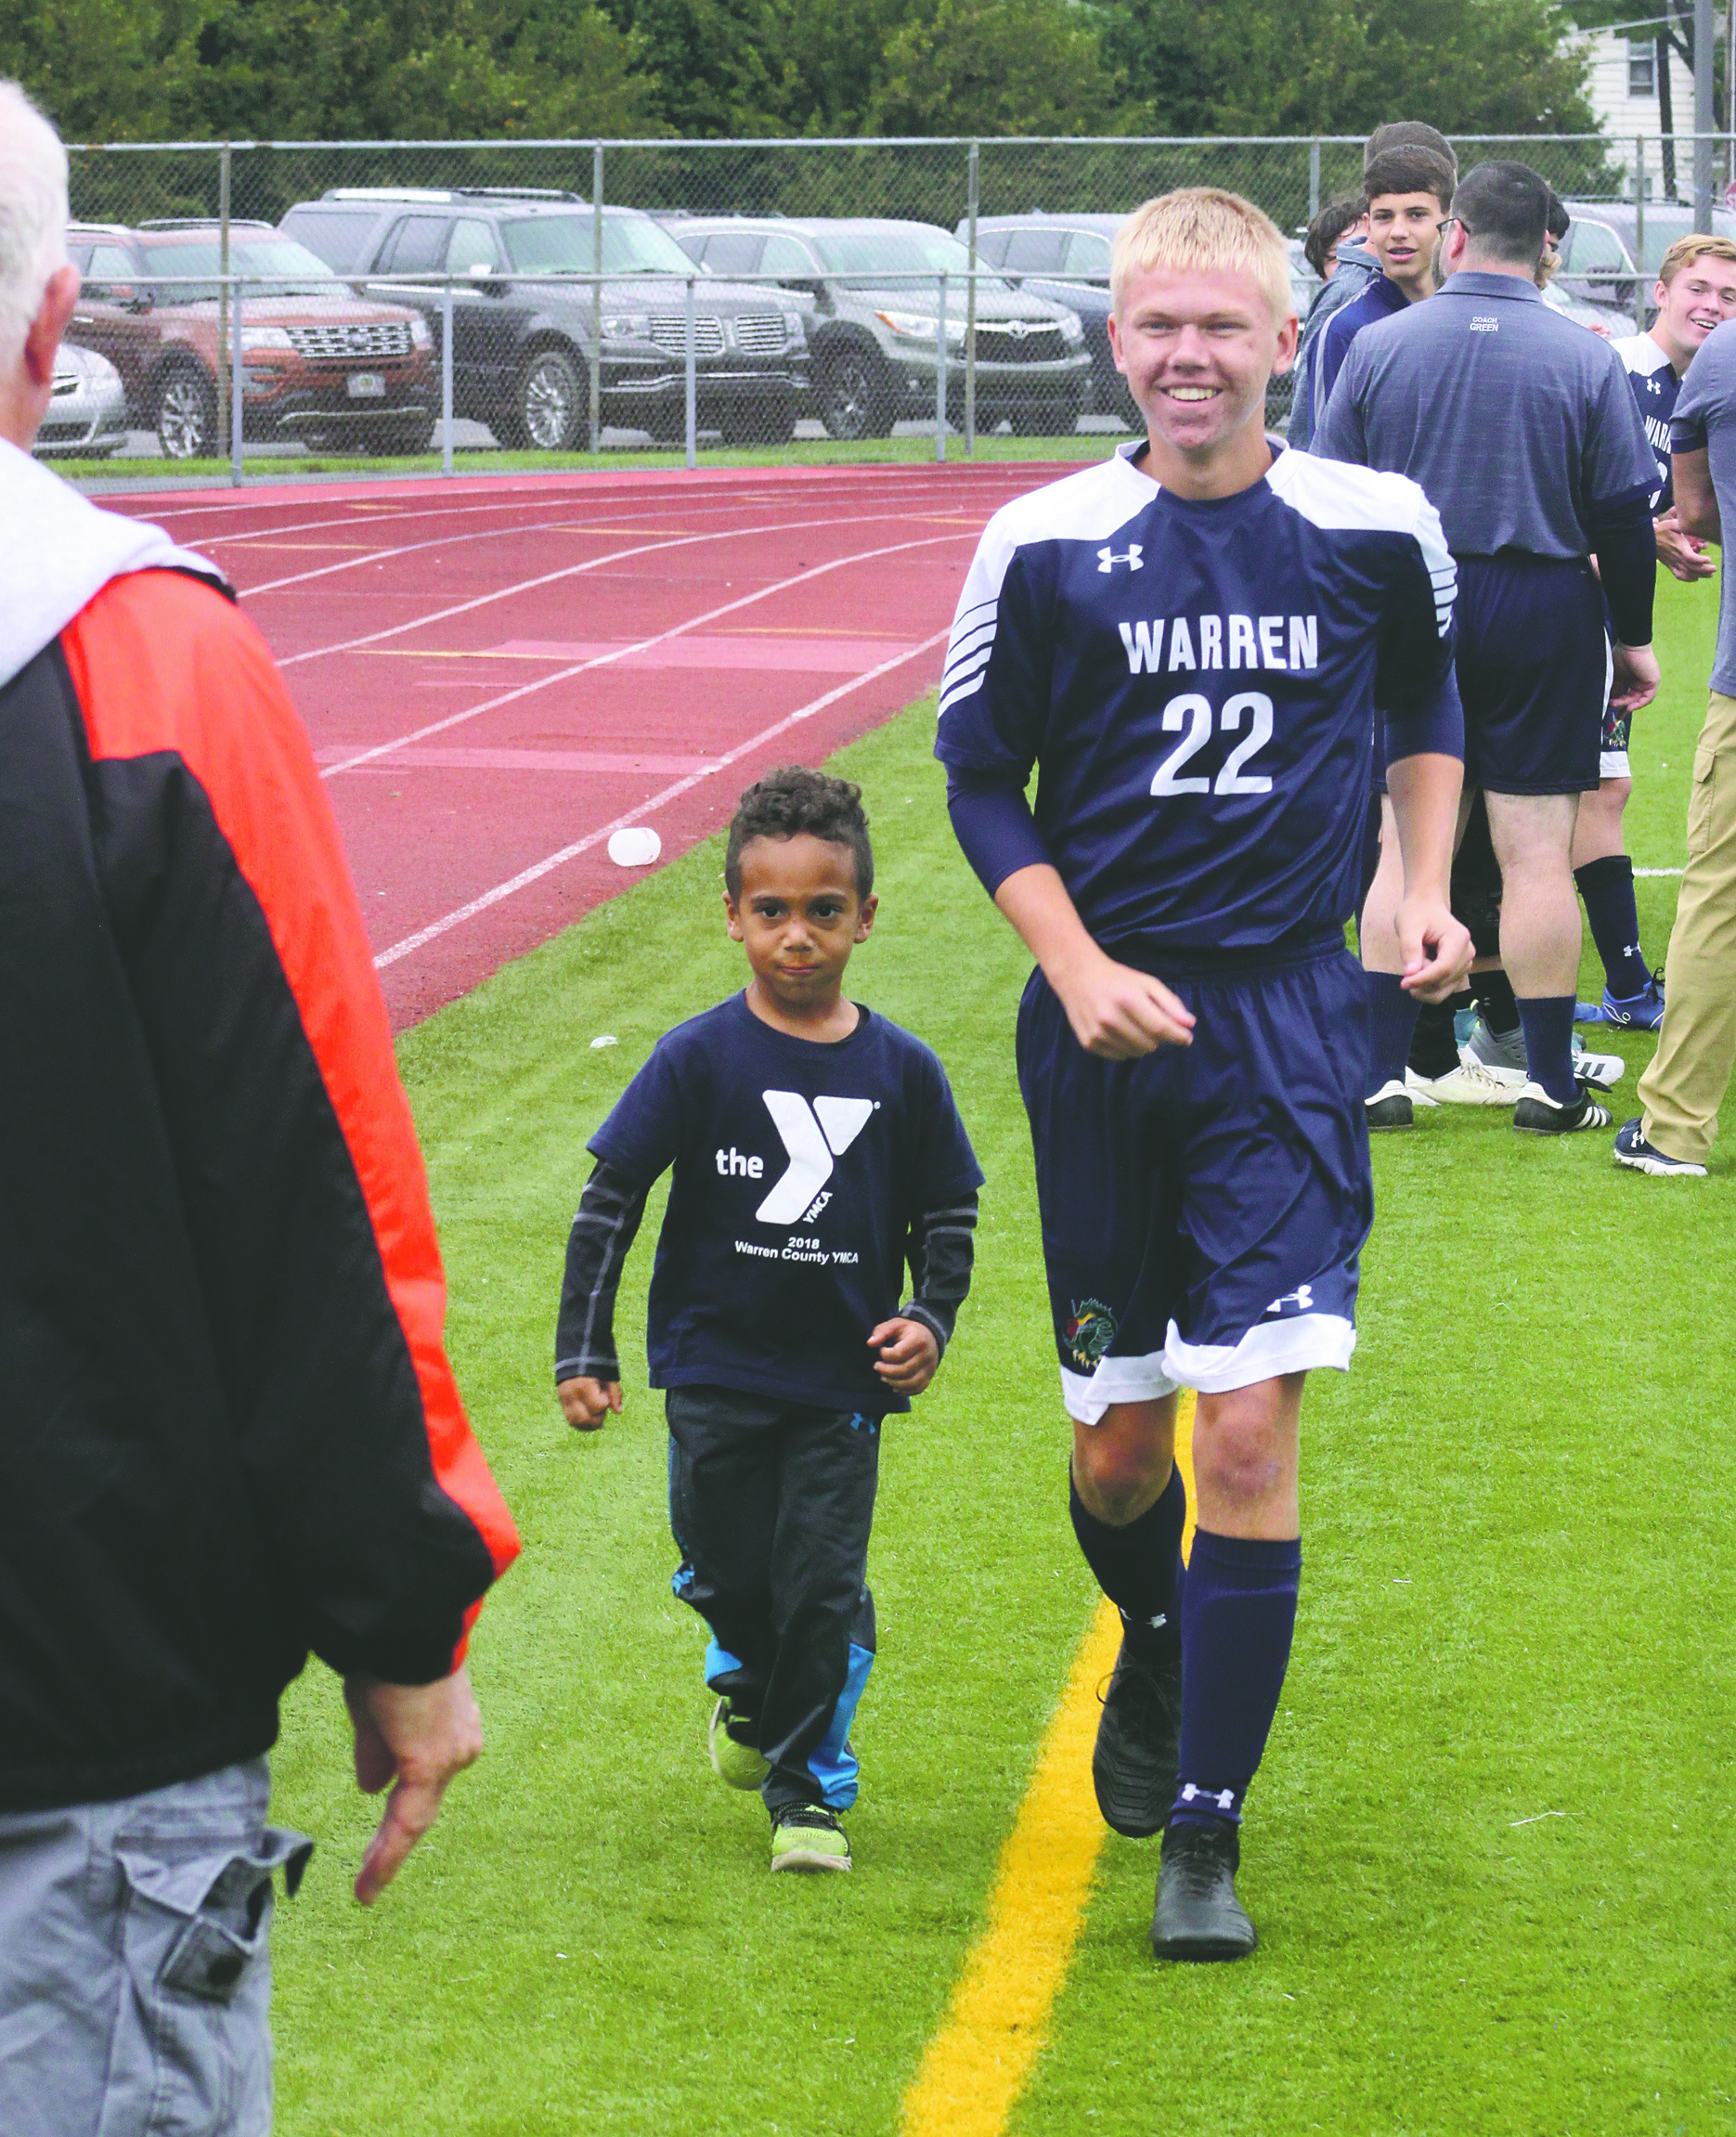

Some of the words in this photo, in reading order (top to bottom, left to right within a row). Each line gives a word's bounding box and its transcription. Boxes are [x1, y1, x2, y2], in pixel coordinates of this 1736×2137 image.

[1470, 323, 1498, 331] GREEN
[1119, 615, 1317, 674] WARREN
[1150, 692, 1274, 797] 22
[716, 1147, 763, 1178] the
[803, 1191, 833, 1224] YMCA
[735, 1240, 778, 1258] Warren
[782, 1248, 829, 1265] County
[832, 1251, 859, 1263] YMCA
[787, 1237, 820, 1250] 2018
